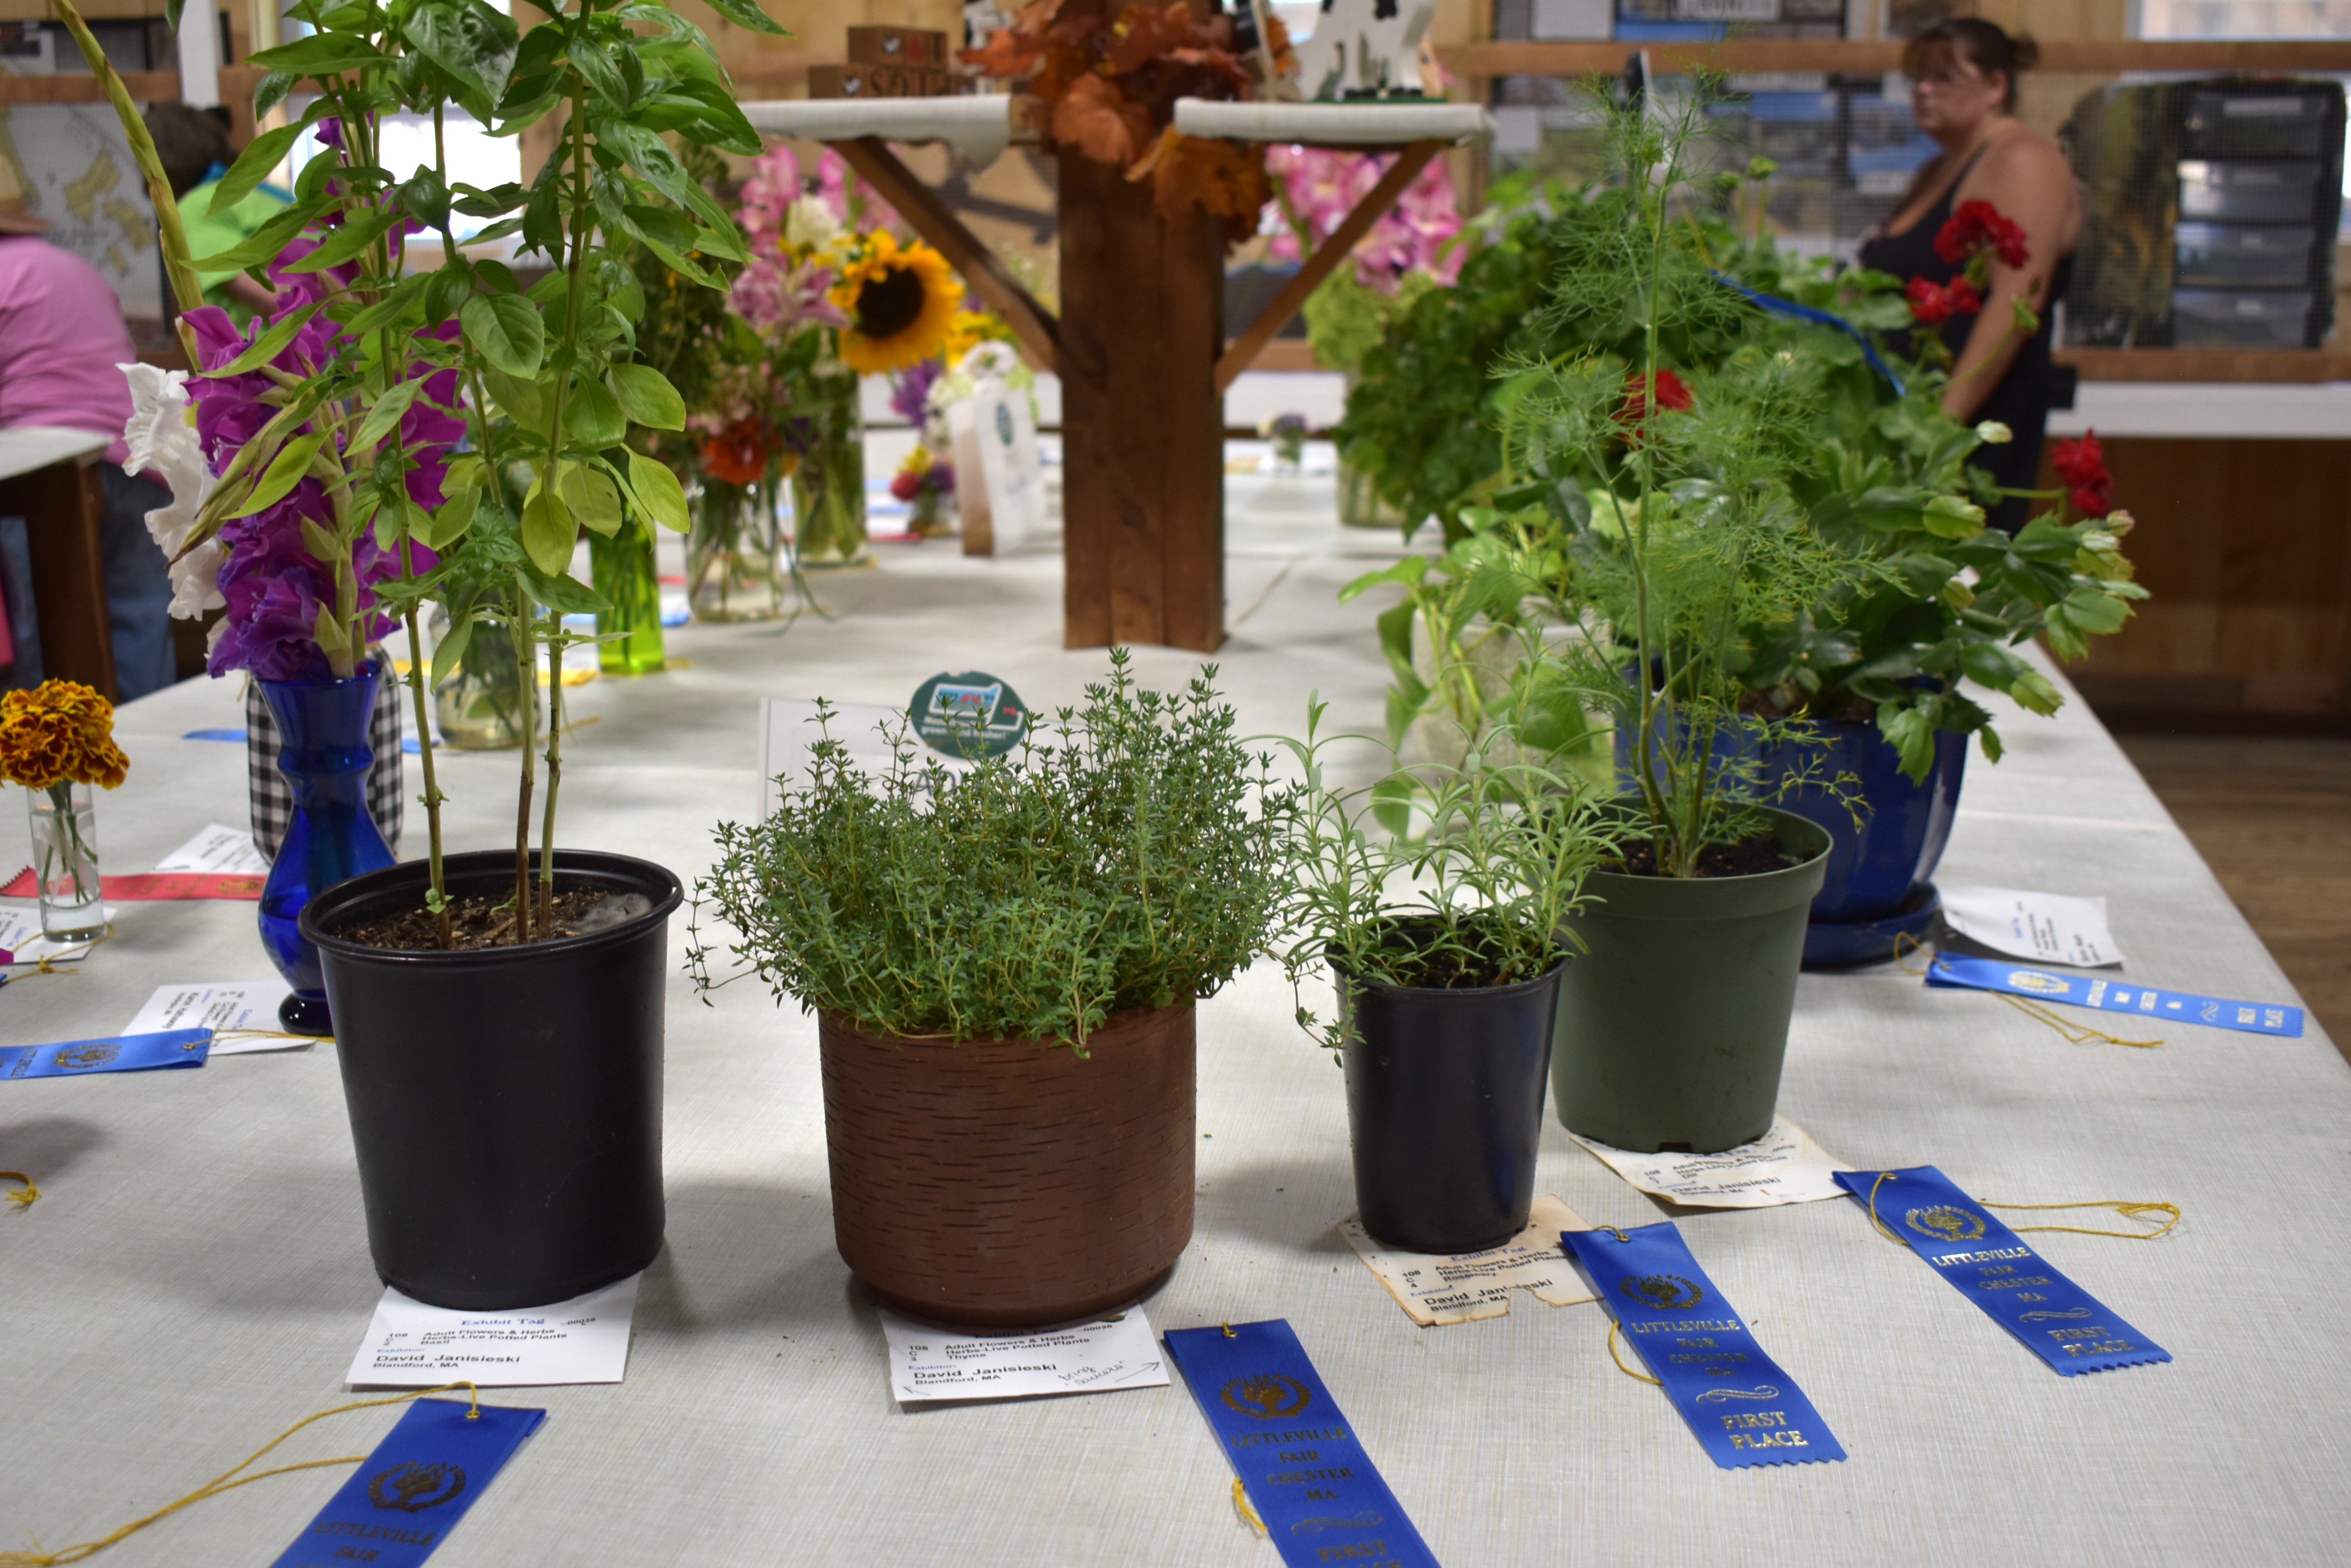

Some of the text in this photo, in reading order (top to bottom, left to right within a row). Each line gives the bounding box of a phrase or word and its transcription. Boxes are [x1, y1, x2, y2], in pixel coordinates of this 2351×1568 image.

[1450, 1246, 1527, 1262] Exhibit Tag
[1931, 1247, 2032, 1267] LITTLEVILLE
[1402, 1270, 1421, 1278] 108
[1464, 1259, 1507, 1268] Flowers
[1518, 1250, 1551, 1261] Herbs
[1497, 1259, 1532, 1270] Potted
[1978, 1265, 2019, 1276] FAIR
[1443, 1272, 1496, 1282] Rosemary
[1978, 1276, 2054, 1290] CHESTER
[1423, 1292, 1470, 1305] David
[1430, 1294, 1509, 1312] Blandford, MA
[1632, 1319, 1741, 1333] LITTLEVILLE
[2047, 1326, 2111, 1342] FIRST
[979, 1339, 1025, 1347] Flowers
[1012, 1342, 1051, 1350] Potted
[1054, 1338, 1089, 1346] Plants
[1676, 1337, 1719, 1349] FAIR
[2062, 1339, 2136, 1358] PLACE
[434, 1354, 520, 1363] Janisieski
[1669, 1352, 1751, 1364] CHESTER
[914, 1363, 1057, 1379] David Janisieski
[1705, 1367, 1736, 1377] MA
[915, 1376, 978, 1385] Blandford,
[1720, 1410, 1788, 1431] FIRST
[1231, 1426, 1349, 1447] LITTLEVILLE
[1729, 1430, 1809, 1450] PLACE
[1278, 1449, 1322, 1464] FAIR
[1266, 1466, 1355, 1486] CHESTER
[1305, 1489, 1339, 1502] MA
[314, 1521, 438, 1546] LITTLEVILLE
[334, 1545, 380, 1562] FAIR
[1316, 1539, 1387, 1562] FIRST
